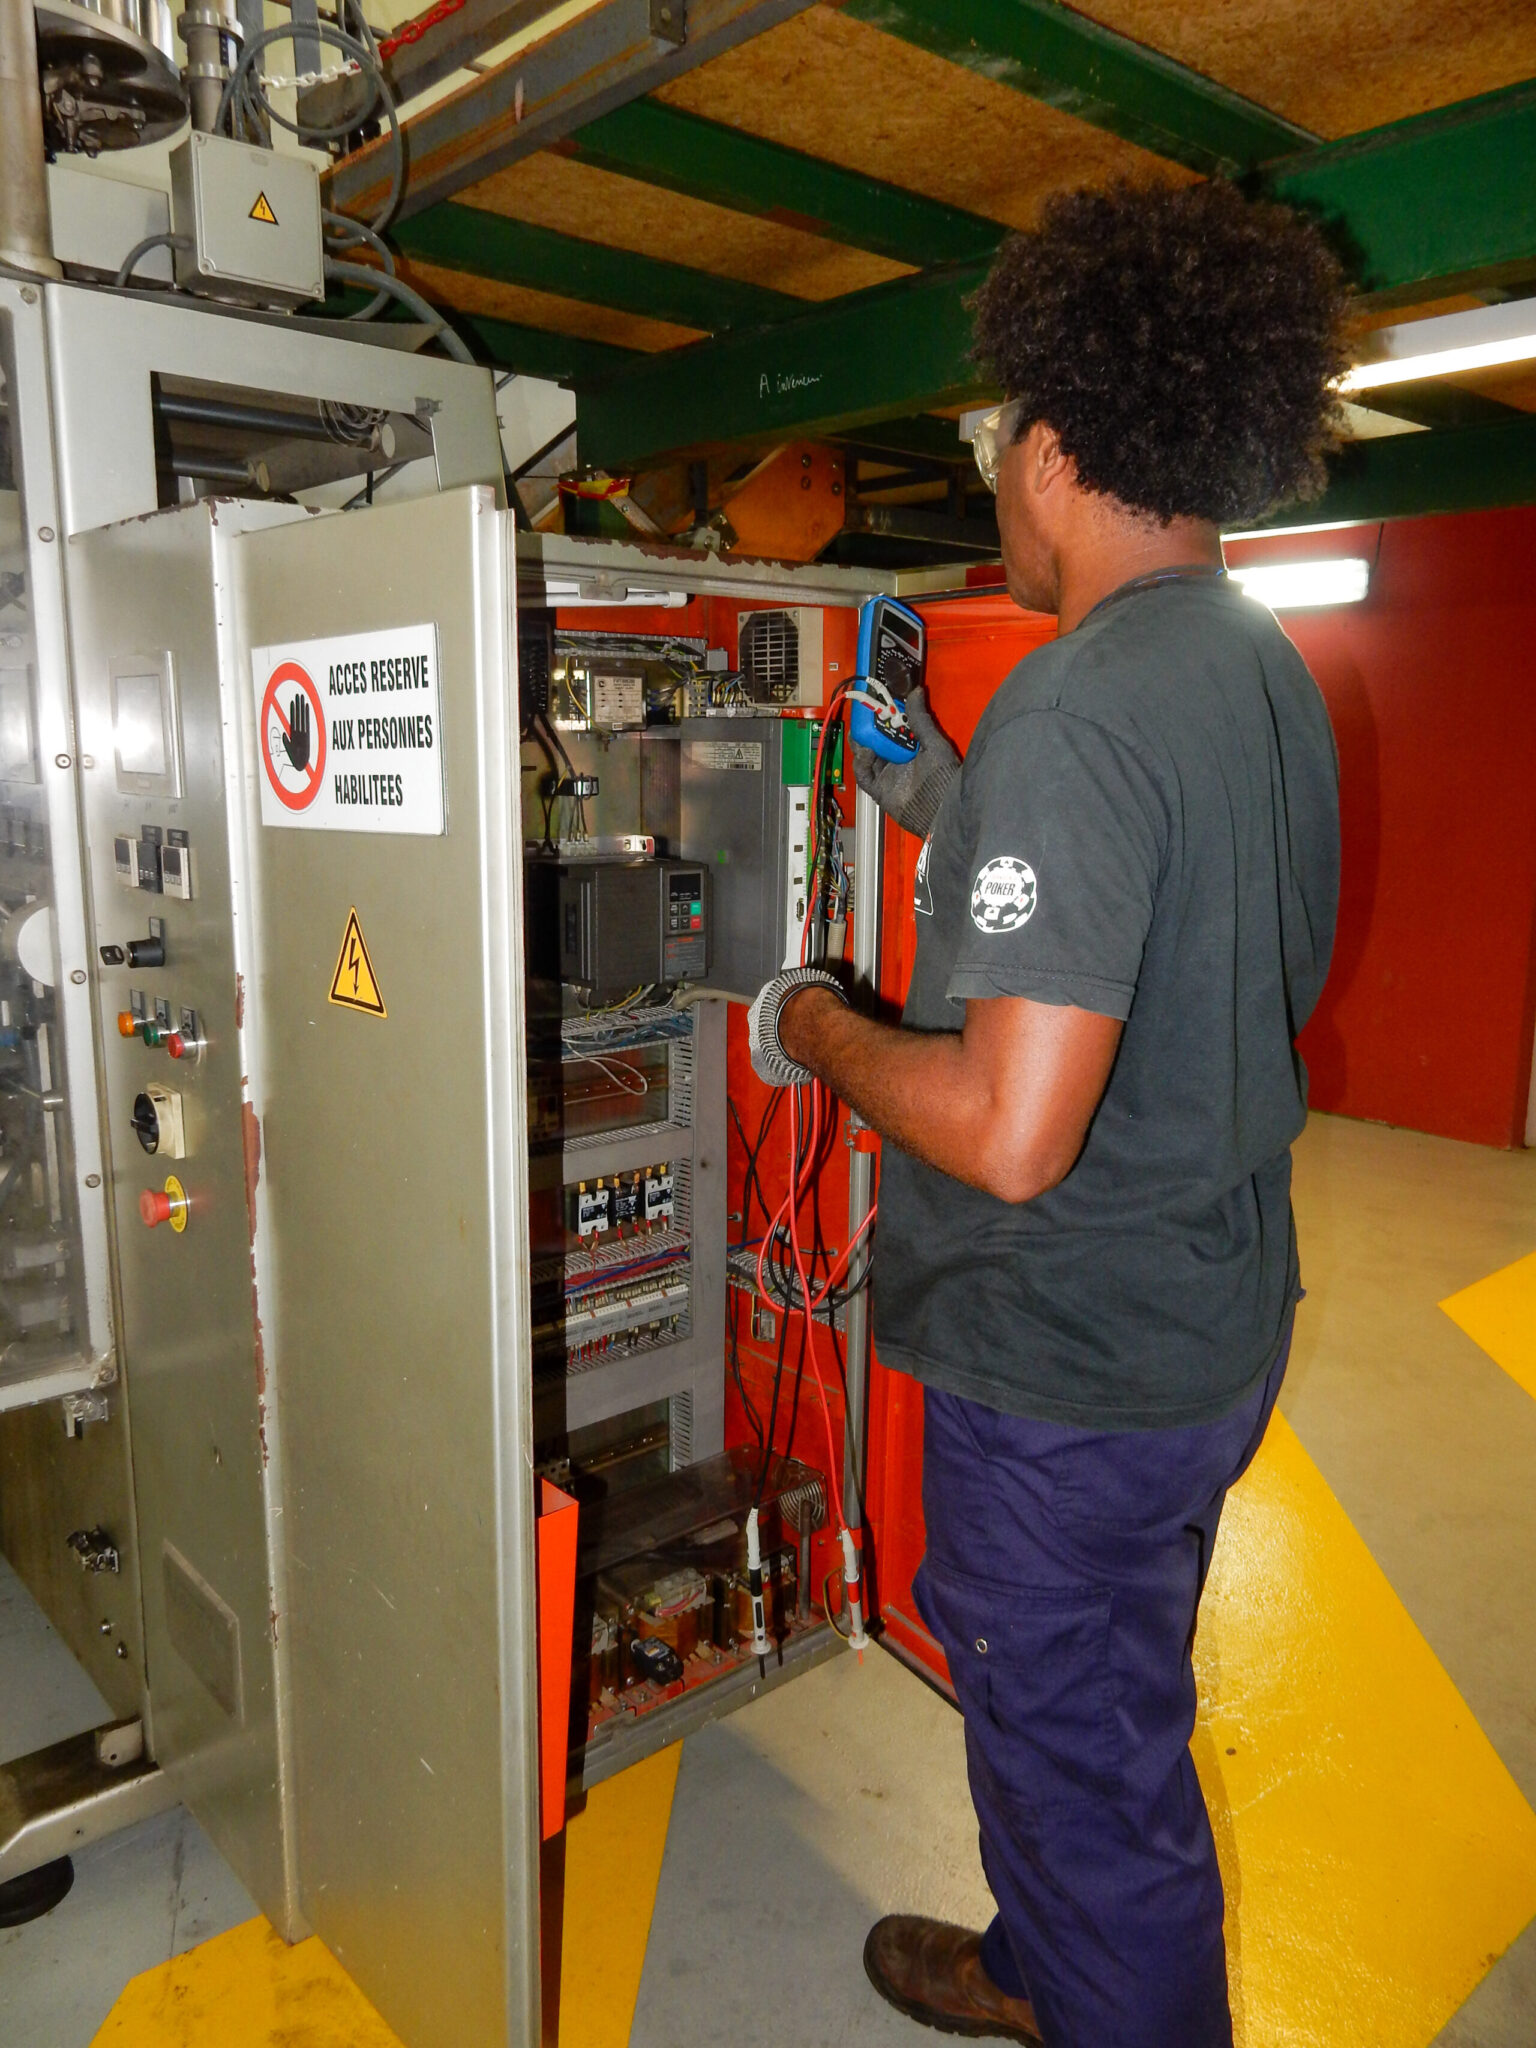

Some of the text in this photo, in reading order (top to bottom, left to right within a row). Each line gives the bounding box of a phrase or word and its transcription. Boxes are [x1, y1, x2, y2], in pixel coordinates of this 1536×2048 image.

[329, 655, 429, 696] ACCES RESERVE
[332, 714, 433, 750] AUX PERSONNES
[334, 774, 403, 806] HABILITEES
[985, 882, 1016, 896] POKER
